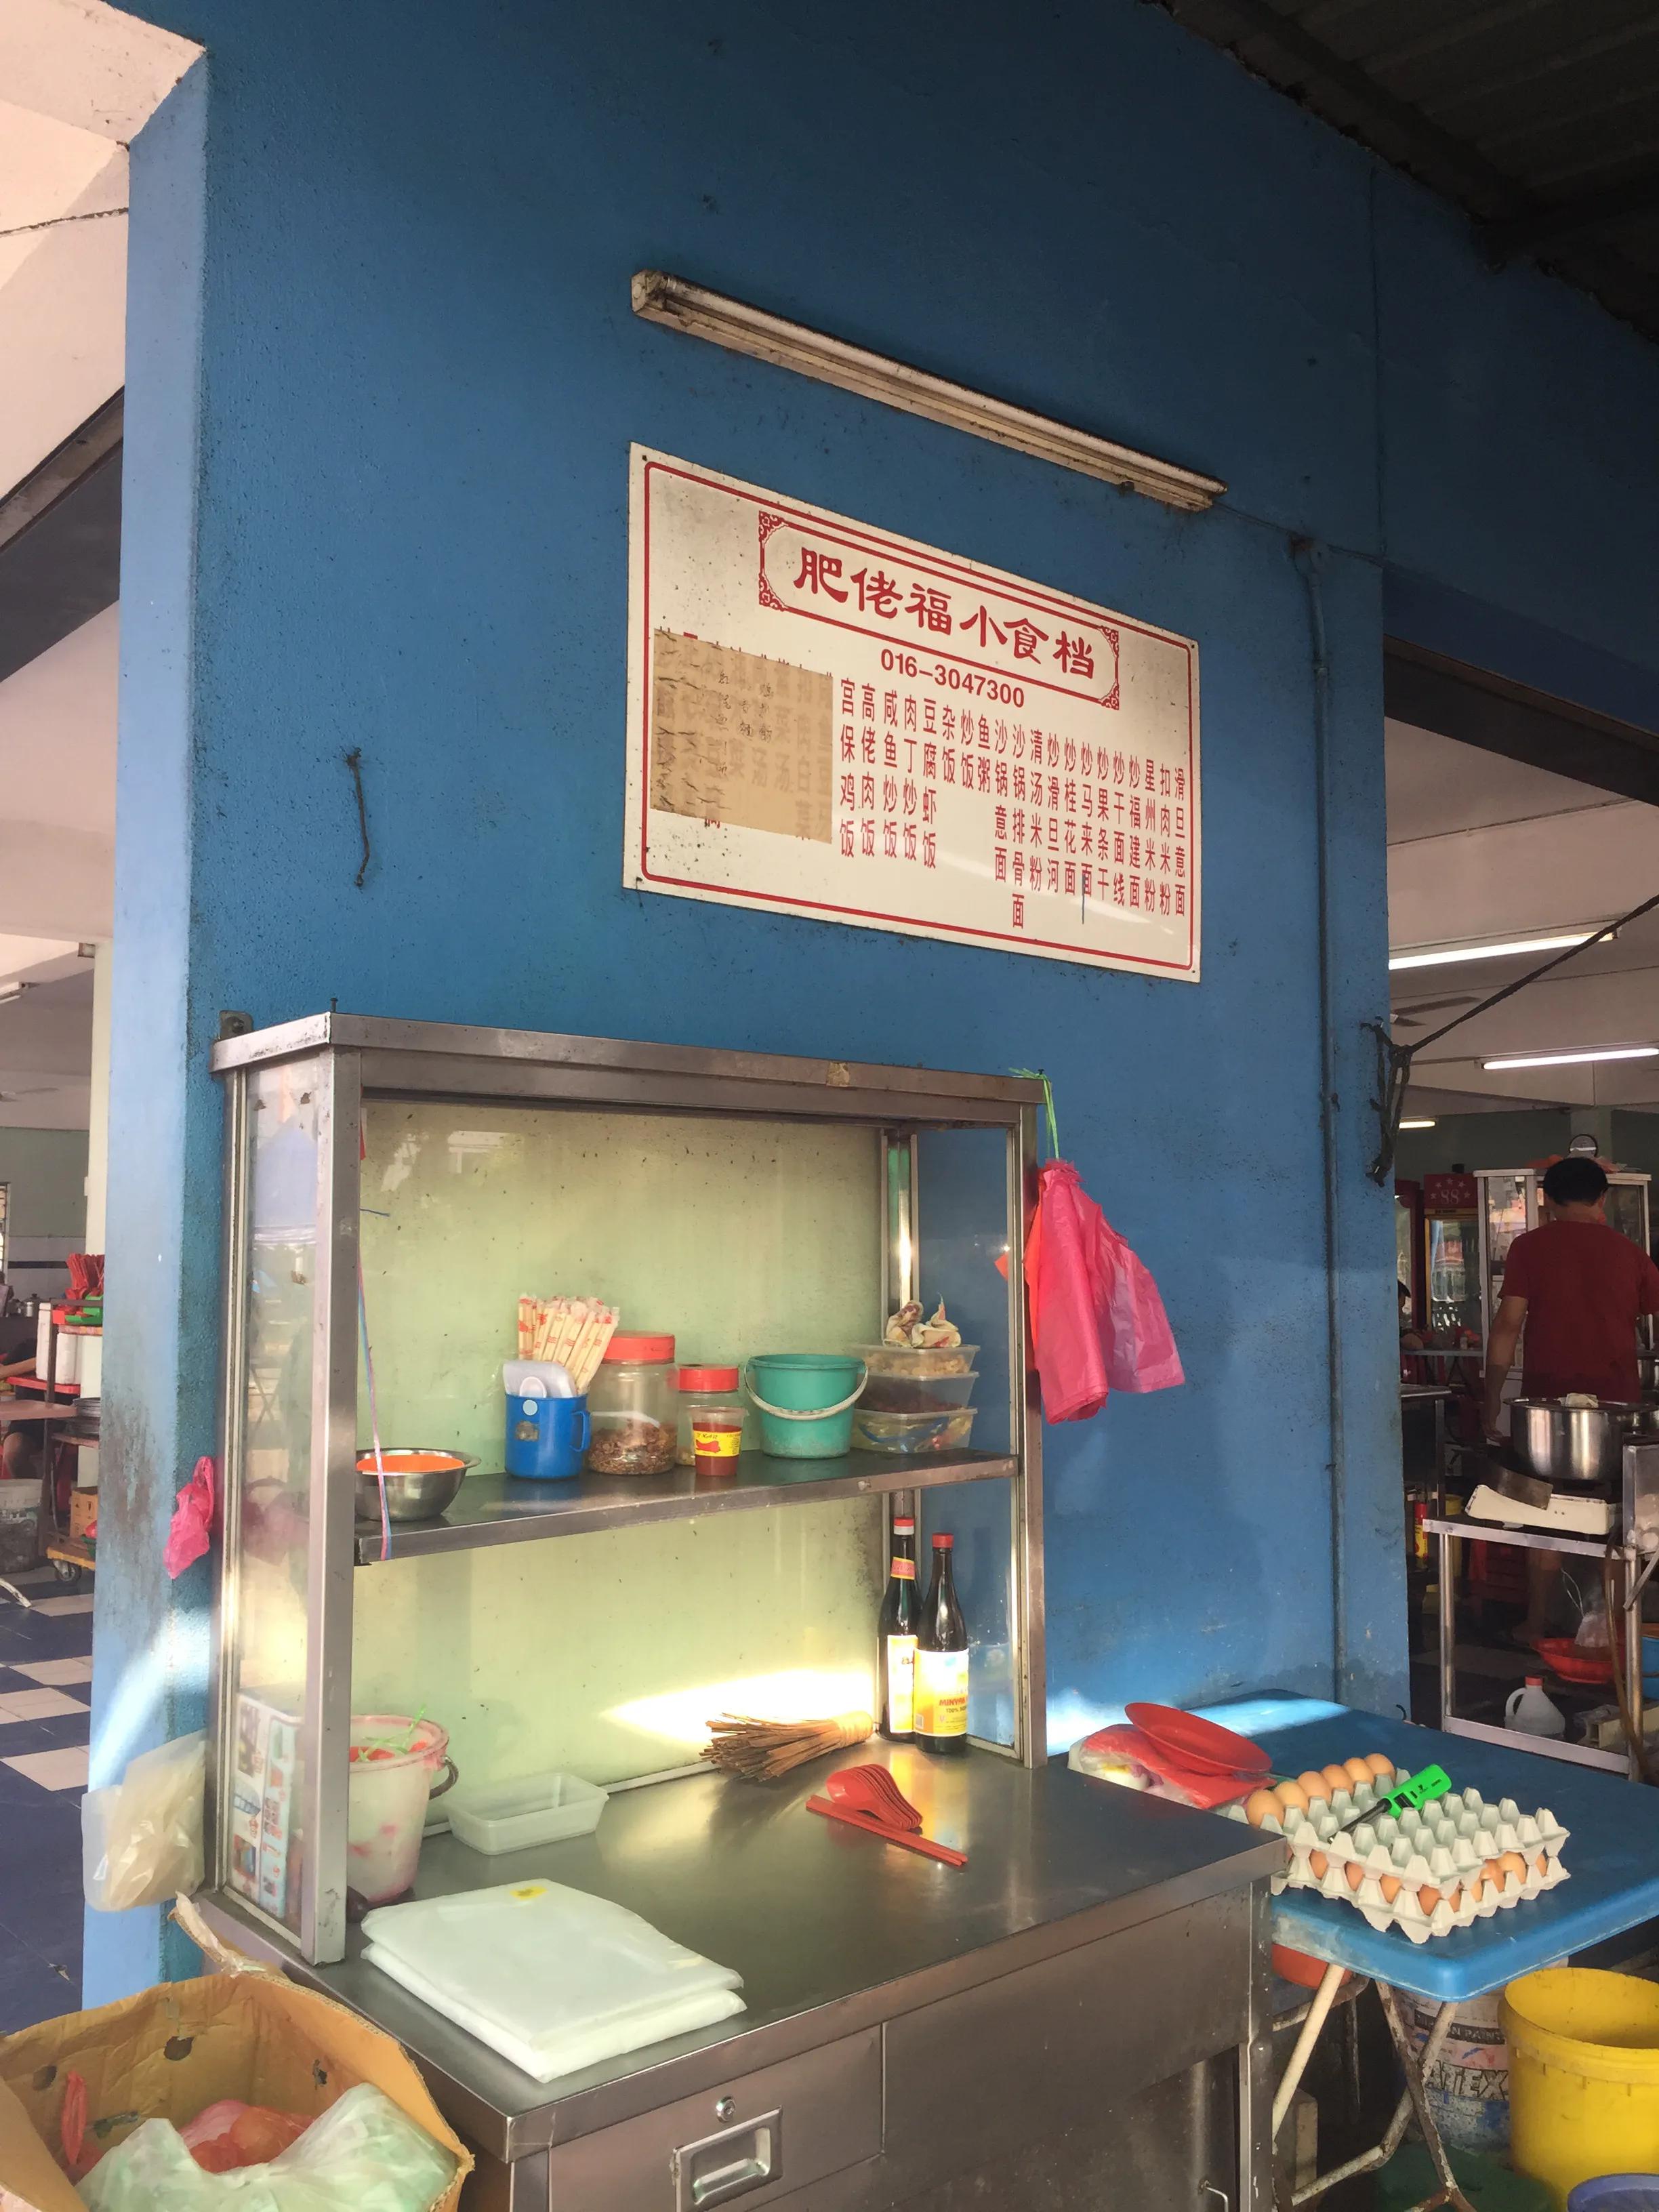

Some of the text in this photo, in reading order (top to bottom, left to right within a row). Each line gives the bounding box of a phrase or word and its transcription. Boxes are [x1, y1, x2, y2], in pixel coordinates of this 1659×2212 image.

[793, 546, 1094, 679] 肥佬福小食档
[880, 648, 1025, 708] 016-3047300
[840, 678, 855, 858] 宫保鸡饭
[861, 683, 876, 857] 高佬肉饭
[883, 689, 898, 859] 咸鱼炒饭
[903, 694, 918, 861] 肉丁炒饭
[922, 697, 937, 869] 豆腐虾饭
[942, 704, 956, 785] 杂饭
[960, 708, 975, 790] 炒饭
[977, 714, 991, 794] 鱼粥
[994, 719, 1008, 884] 沙锅意面
[1029, 729, 1043, 893] 清汤米粉
[1064, 737, 1077, 897] 炒桂花面
[1081, 741, 1093, 898] 炒马来面
[1012, 724, 1025, 929] 沙锅排骨面
[1097, 746, 1109, 901] 炒果条干
[1113, 750, 1126, 907] 炒干面线
[1128, 754, 1141, 909] 炒福建面
[1144, 758, 1156, 913] 星州米粉
[1160, 763, 1172, 916] 扣肉米粉
